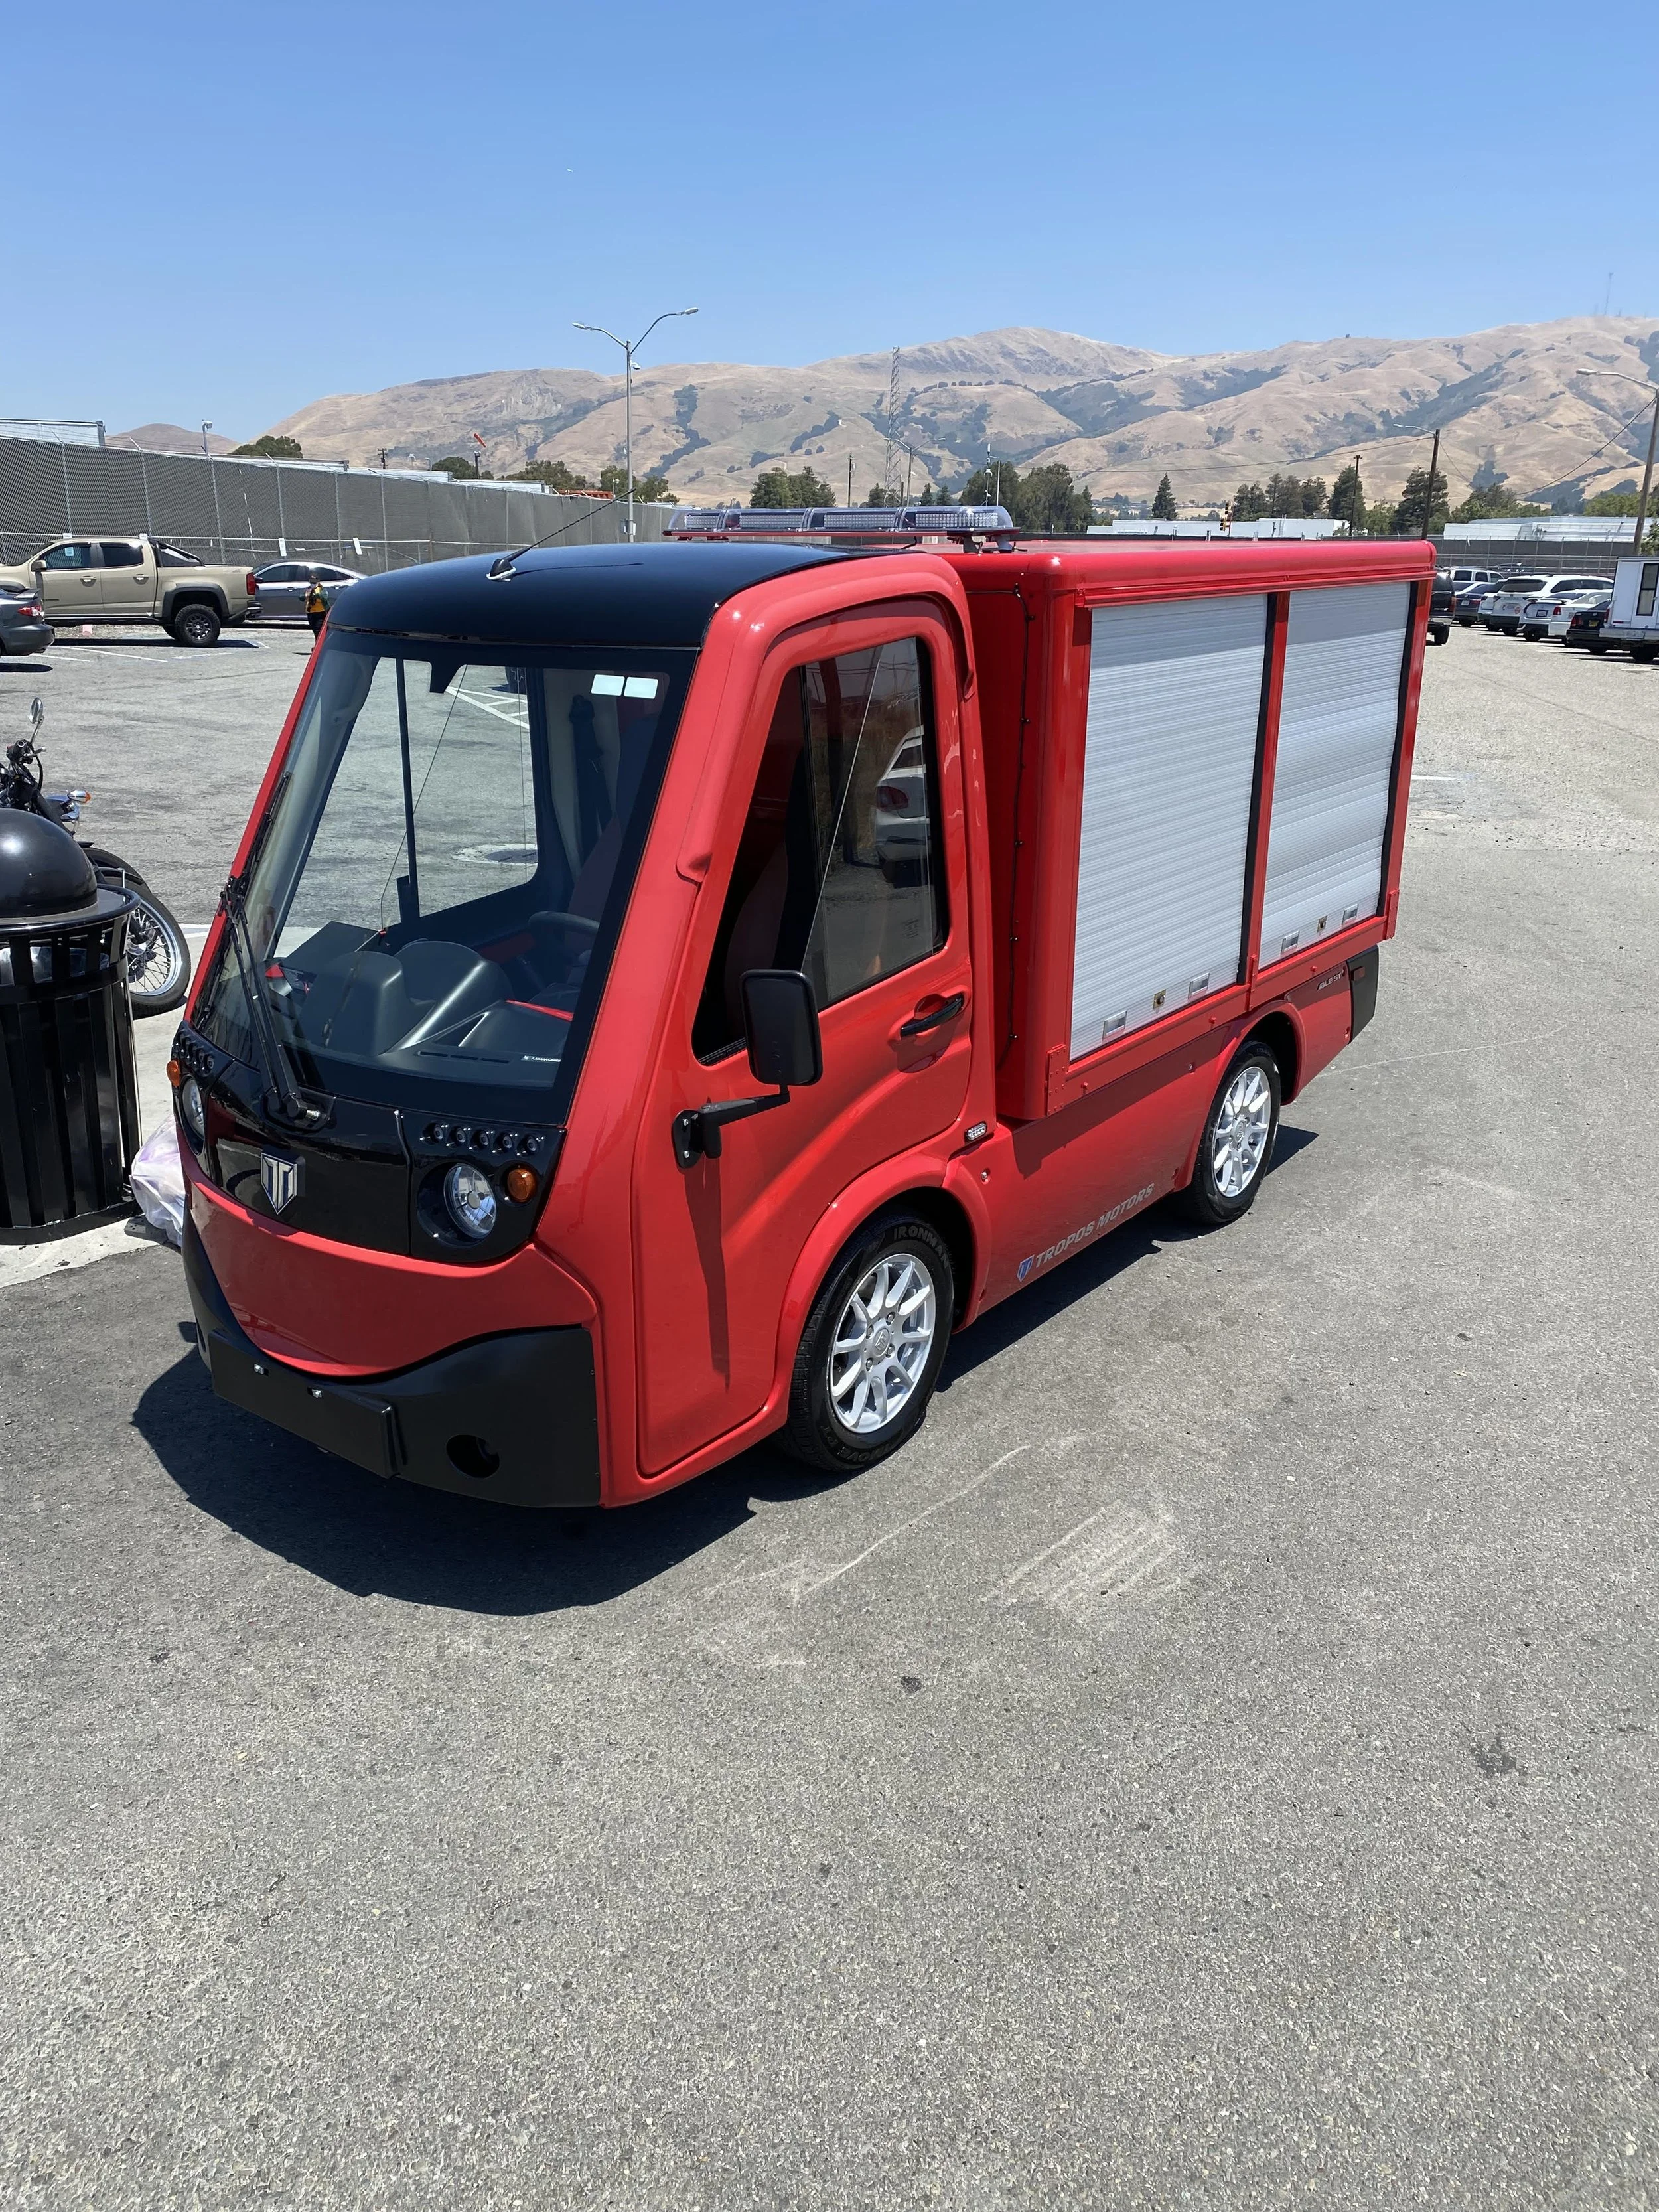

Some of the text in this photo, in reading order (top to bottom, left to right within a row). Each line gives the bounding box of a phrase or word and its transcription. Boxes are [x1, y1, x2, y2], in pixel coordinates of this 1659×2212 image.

[893, 1226, 949, 1268] IRONMAN
[1036, 1183, 1154, 1268] TROPOS MOTORS
